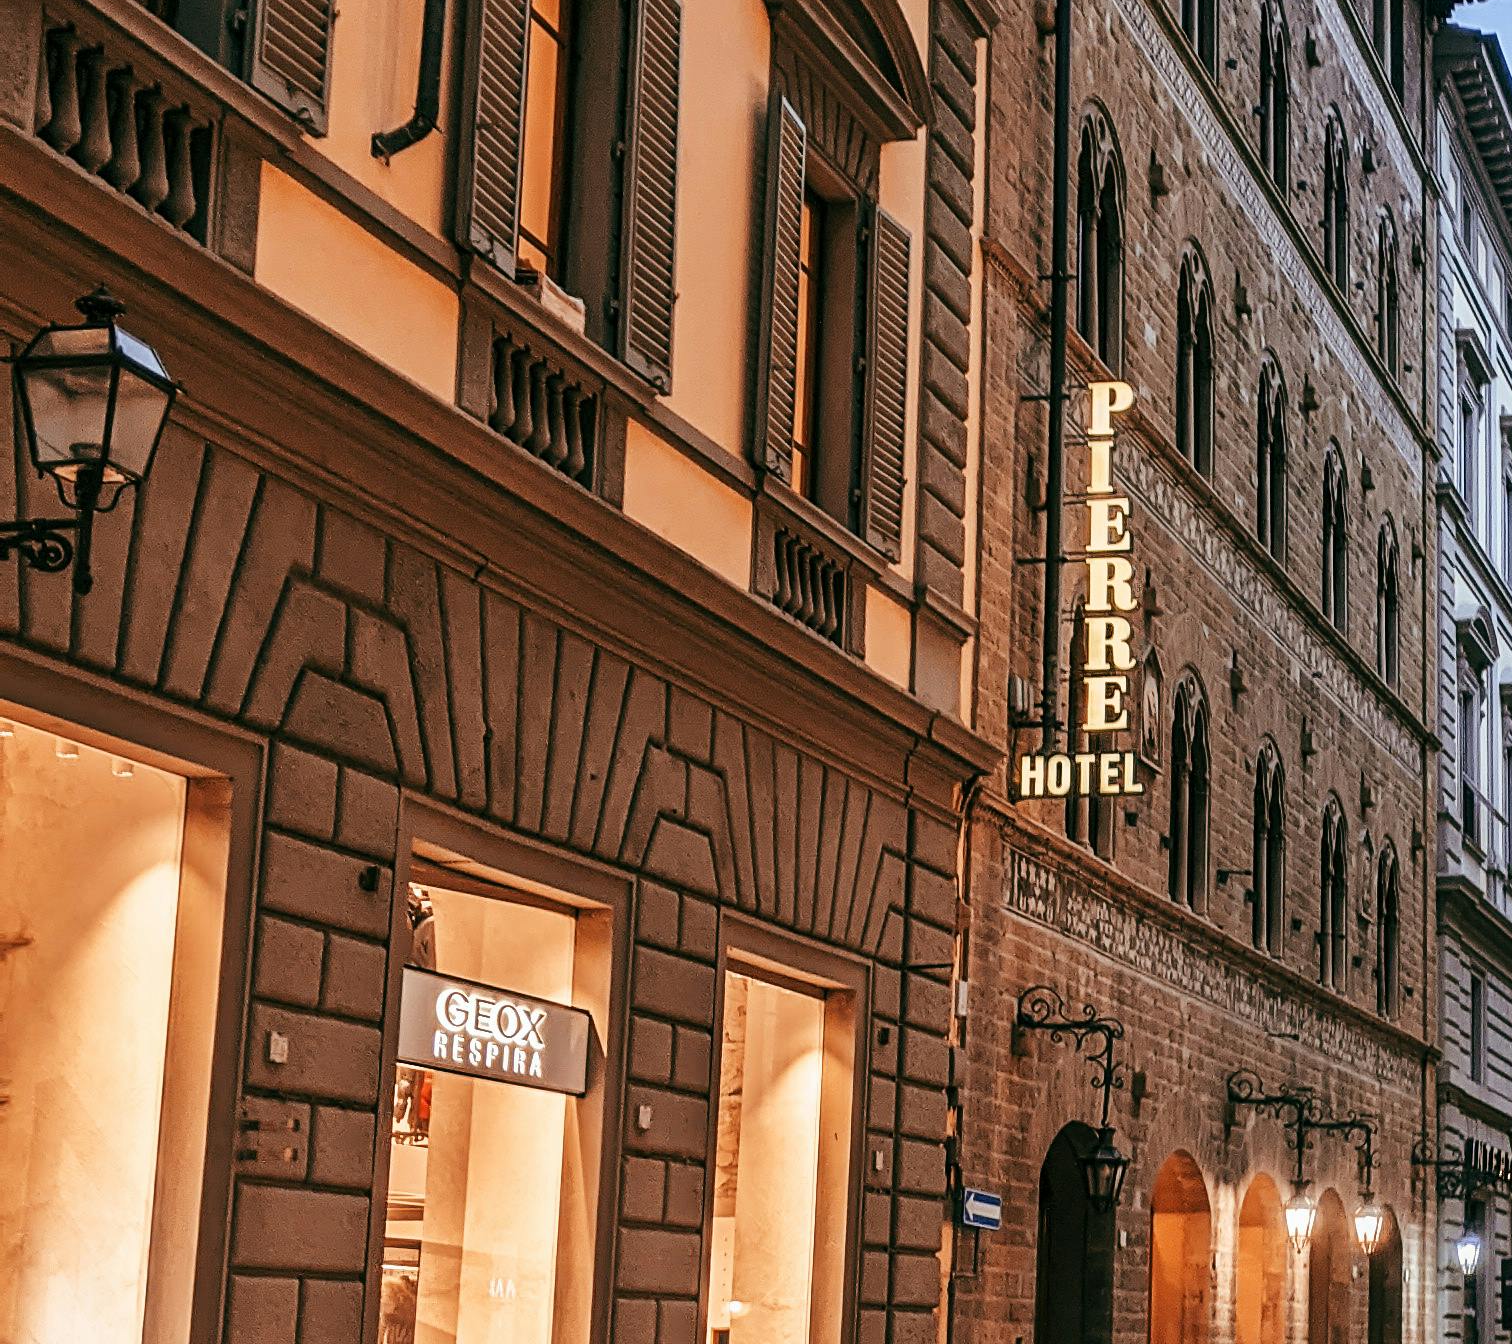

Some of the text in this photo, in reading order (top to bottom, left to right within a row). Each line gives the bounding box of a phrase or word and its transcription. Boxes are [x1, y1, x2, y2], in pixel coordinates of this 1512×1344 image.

[1083, 381, 1138, 731] PIERRE
[1020, 752, 1144, 797] HOTEL
[436, 988, 547, 1049] GEOX
[433, 1030, 542, 1078] RESPIRA
